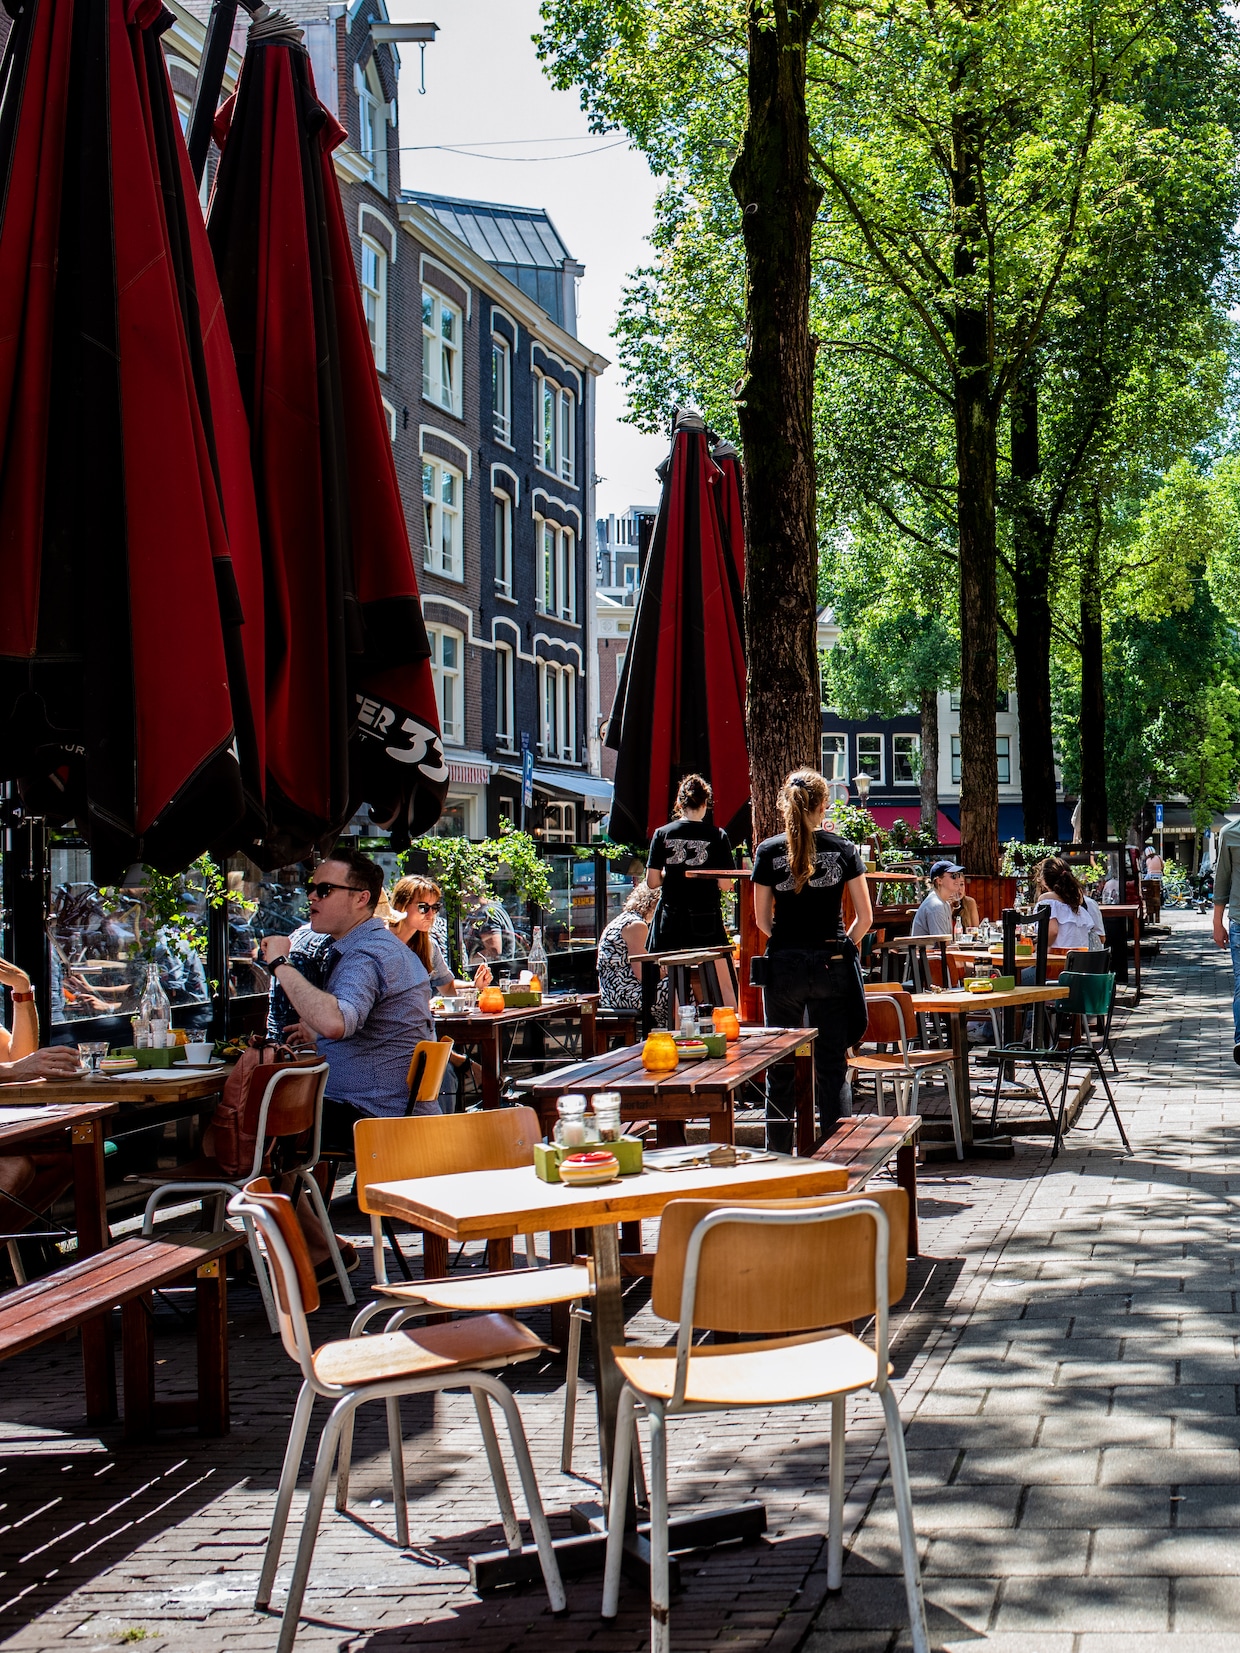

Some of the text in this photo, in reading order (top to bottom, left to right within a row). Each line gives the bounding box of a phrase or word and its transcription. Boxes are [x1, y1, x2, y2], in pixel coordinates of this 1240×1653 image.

[355, 693, 449, 783] ER 33
[664, 838, 711, 866] 33
